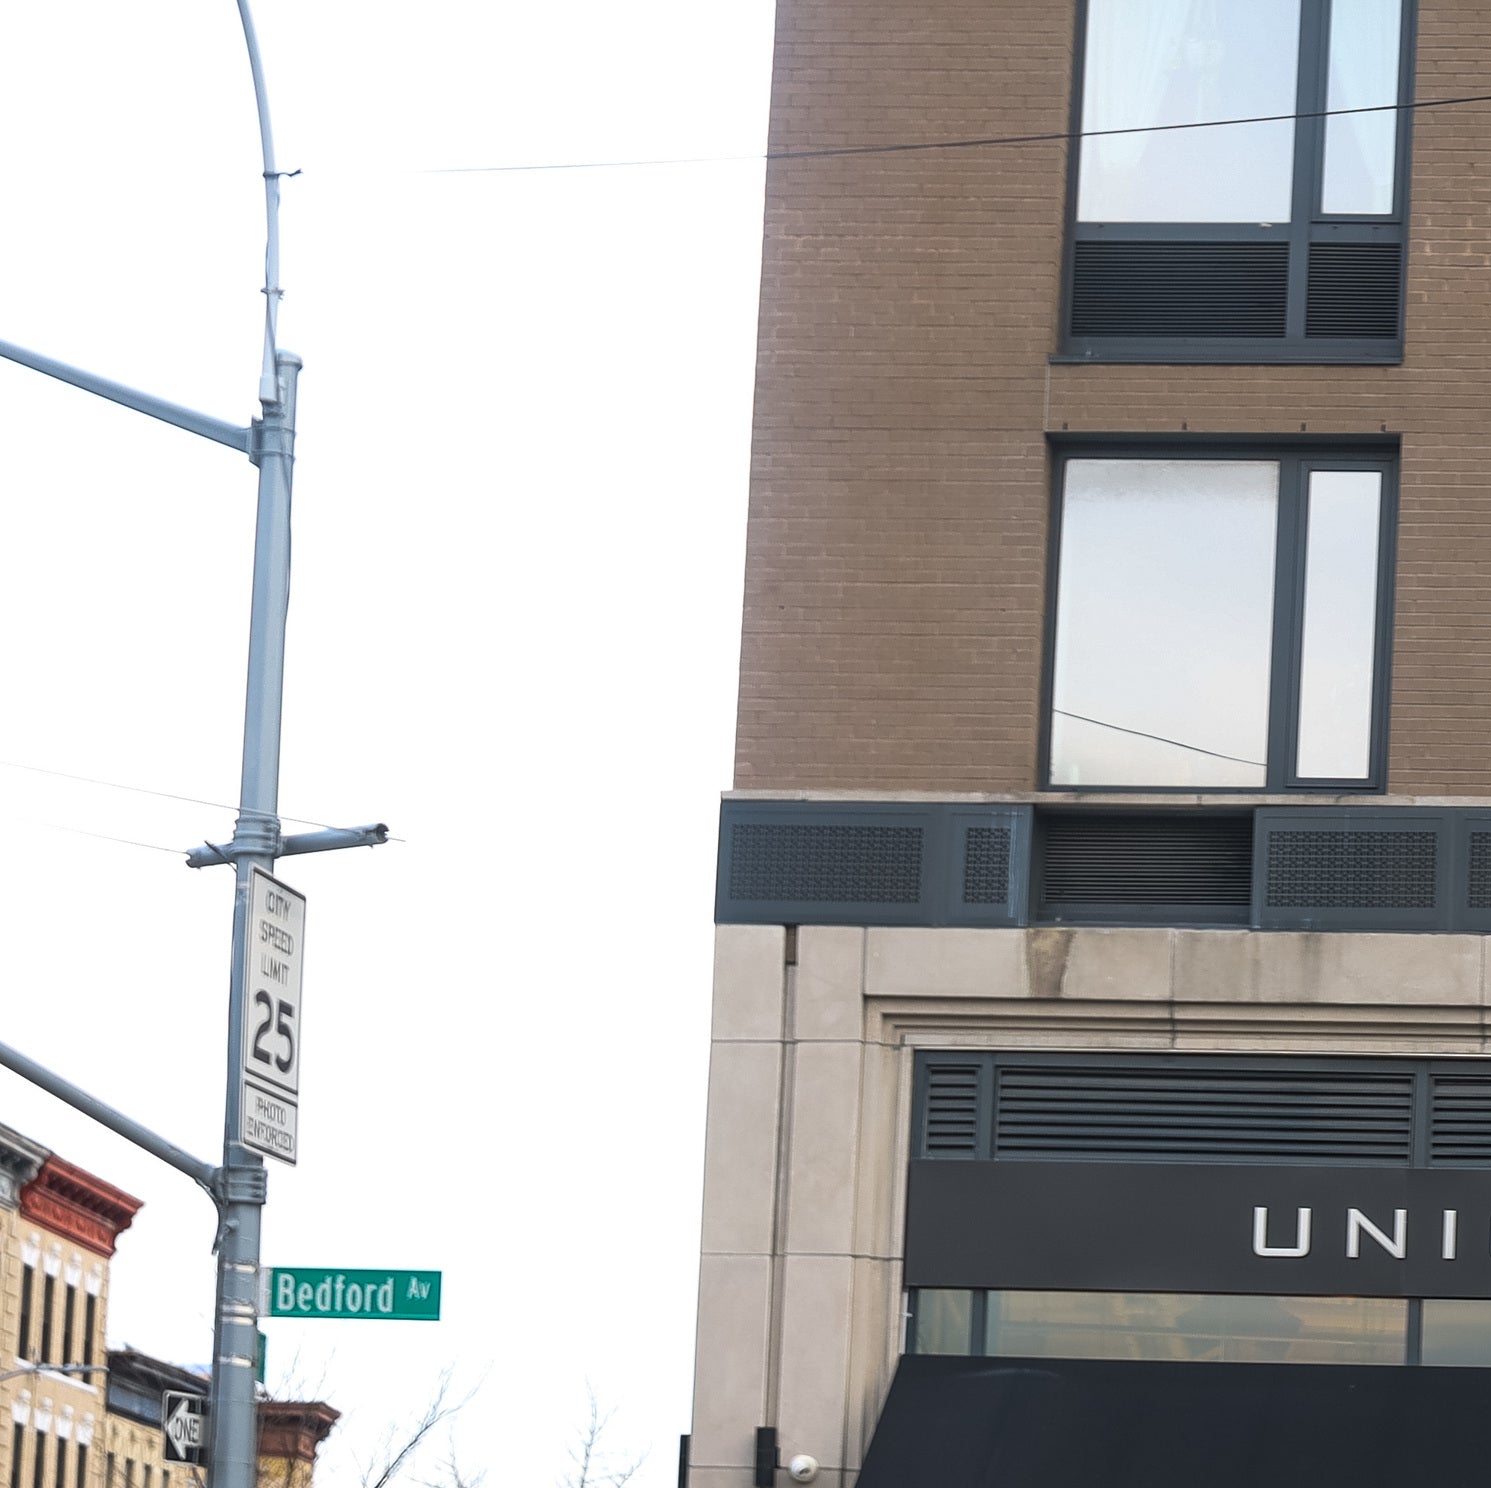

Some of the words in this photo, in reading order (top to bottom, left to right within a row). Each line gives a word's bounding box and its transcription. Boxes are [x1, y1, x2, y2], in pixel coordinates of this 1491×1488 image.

[265, 889, 291, 922] CITY
[260, 919, 295, 957] SPEED
[261, 953, 290, 985] LIMIT
[253, 989, 296, 1076] 25
[256, 1095, 287, 1125] PHOTO
[246, 1115, 295, 1153] ENFORCED
[276, 1272, 395, 1314] Bedford
[406, 1275, 432, 1300] Av
[174, 1417, 200, 1443] ONE
